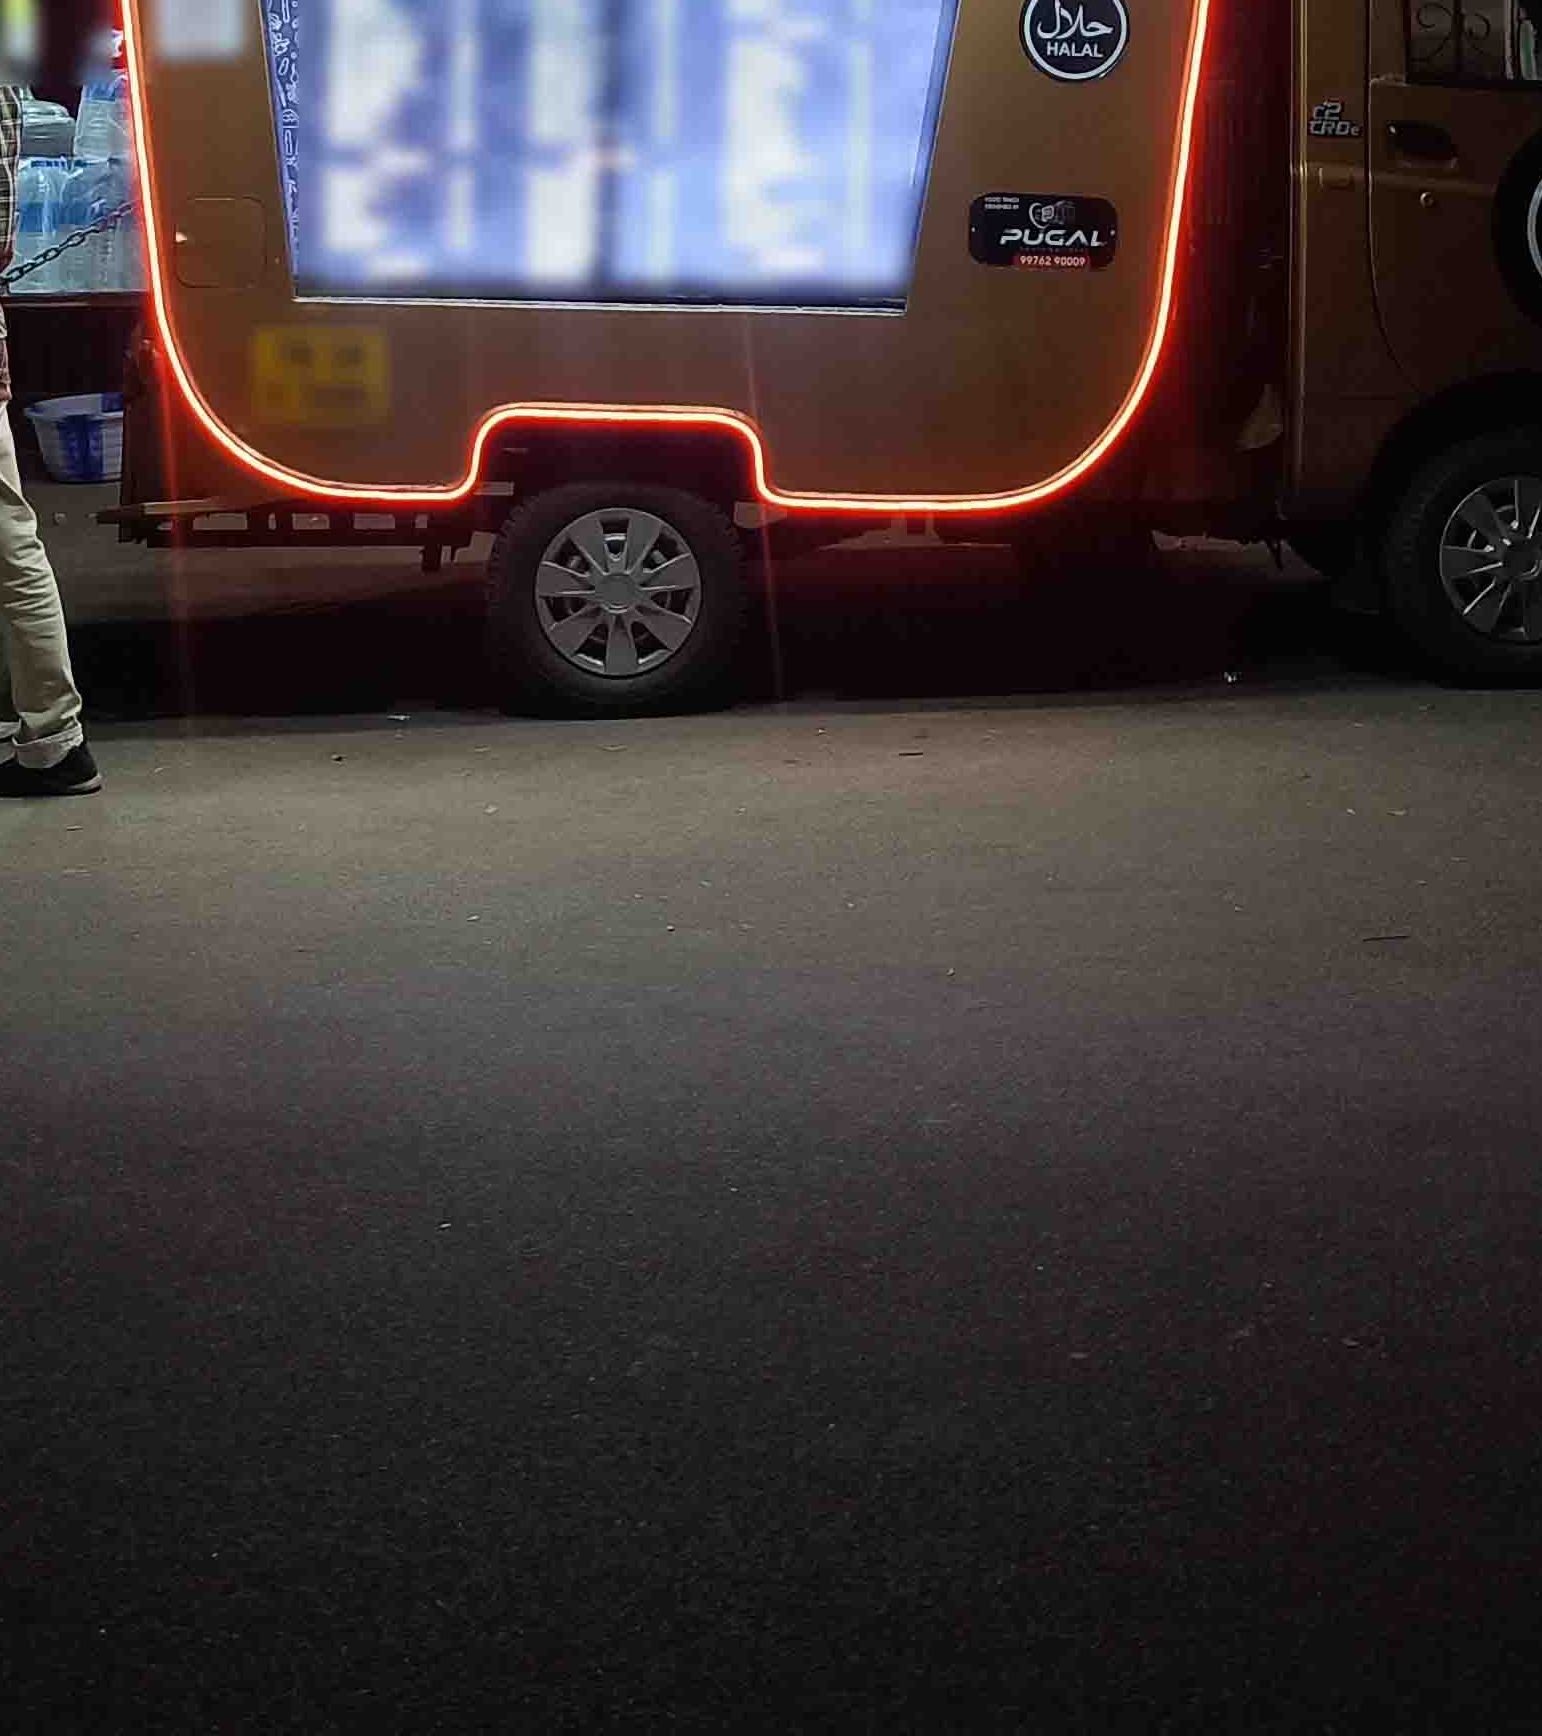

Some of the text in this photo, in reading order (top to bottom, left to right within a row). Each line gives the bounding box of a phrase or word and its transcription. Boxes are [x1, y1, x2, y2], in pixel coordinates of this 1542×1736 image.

[1036, 0, 1114, 39] حلال
[1046, 41, 1104, 58] HALAL
[999, 228, 1107, 247] PUGAL
[1019, 255, 1086, 267] 99762 90009
